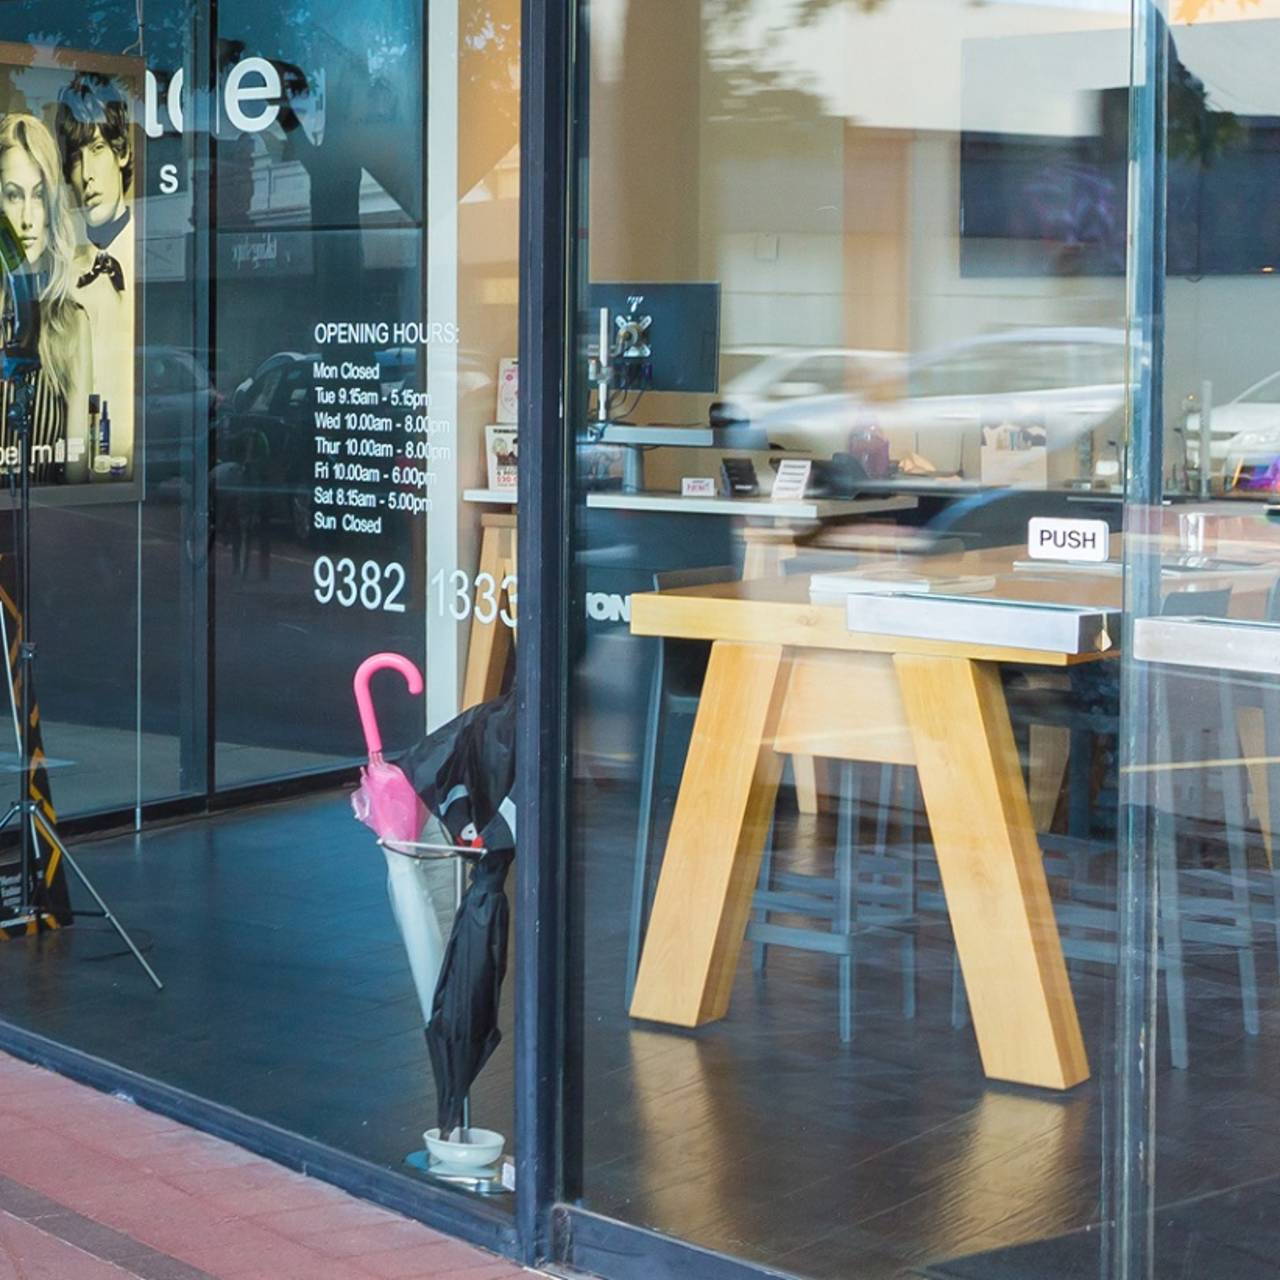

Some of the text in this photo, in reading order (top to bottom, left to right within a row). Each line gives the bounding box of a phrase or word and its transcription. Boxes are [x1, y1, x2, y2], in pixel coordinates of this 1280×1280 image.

[314, 322, 460, 344] OPENING HOURS:
[313, 362, 380, 380] Mon Closed
[315, 387, 335, 404] Tue
[339, 387, 378, 405] 9.15am
[390, 389, 433, 410] 5.15pm
[315, 412, 340, 430] Wed
[344, 413, 392, 431] 10.00am
[405, 415, 450, 434] 8.00pm
[315, 437, 340, 455] Thur
[345, 439, 393, 457] 10.00am
[405, 441, 450, 460] 8.00pm
[315, 462, 329, 479] Fri
[332, 463, 380, 482] 10.00am
[392, 466, 437, 489] 6.00pm
[314, 487, 333, 504] Sat
[336, 488, 376, 507] 8.15am
[388, 492, 433, 514] 5.00pm
[314, 512, 382, 533] Sun Closed
[1039, 529, 1097, 549] PUSH
[313, 555, 406, 612] 9382
